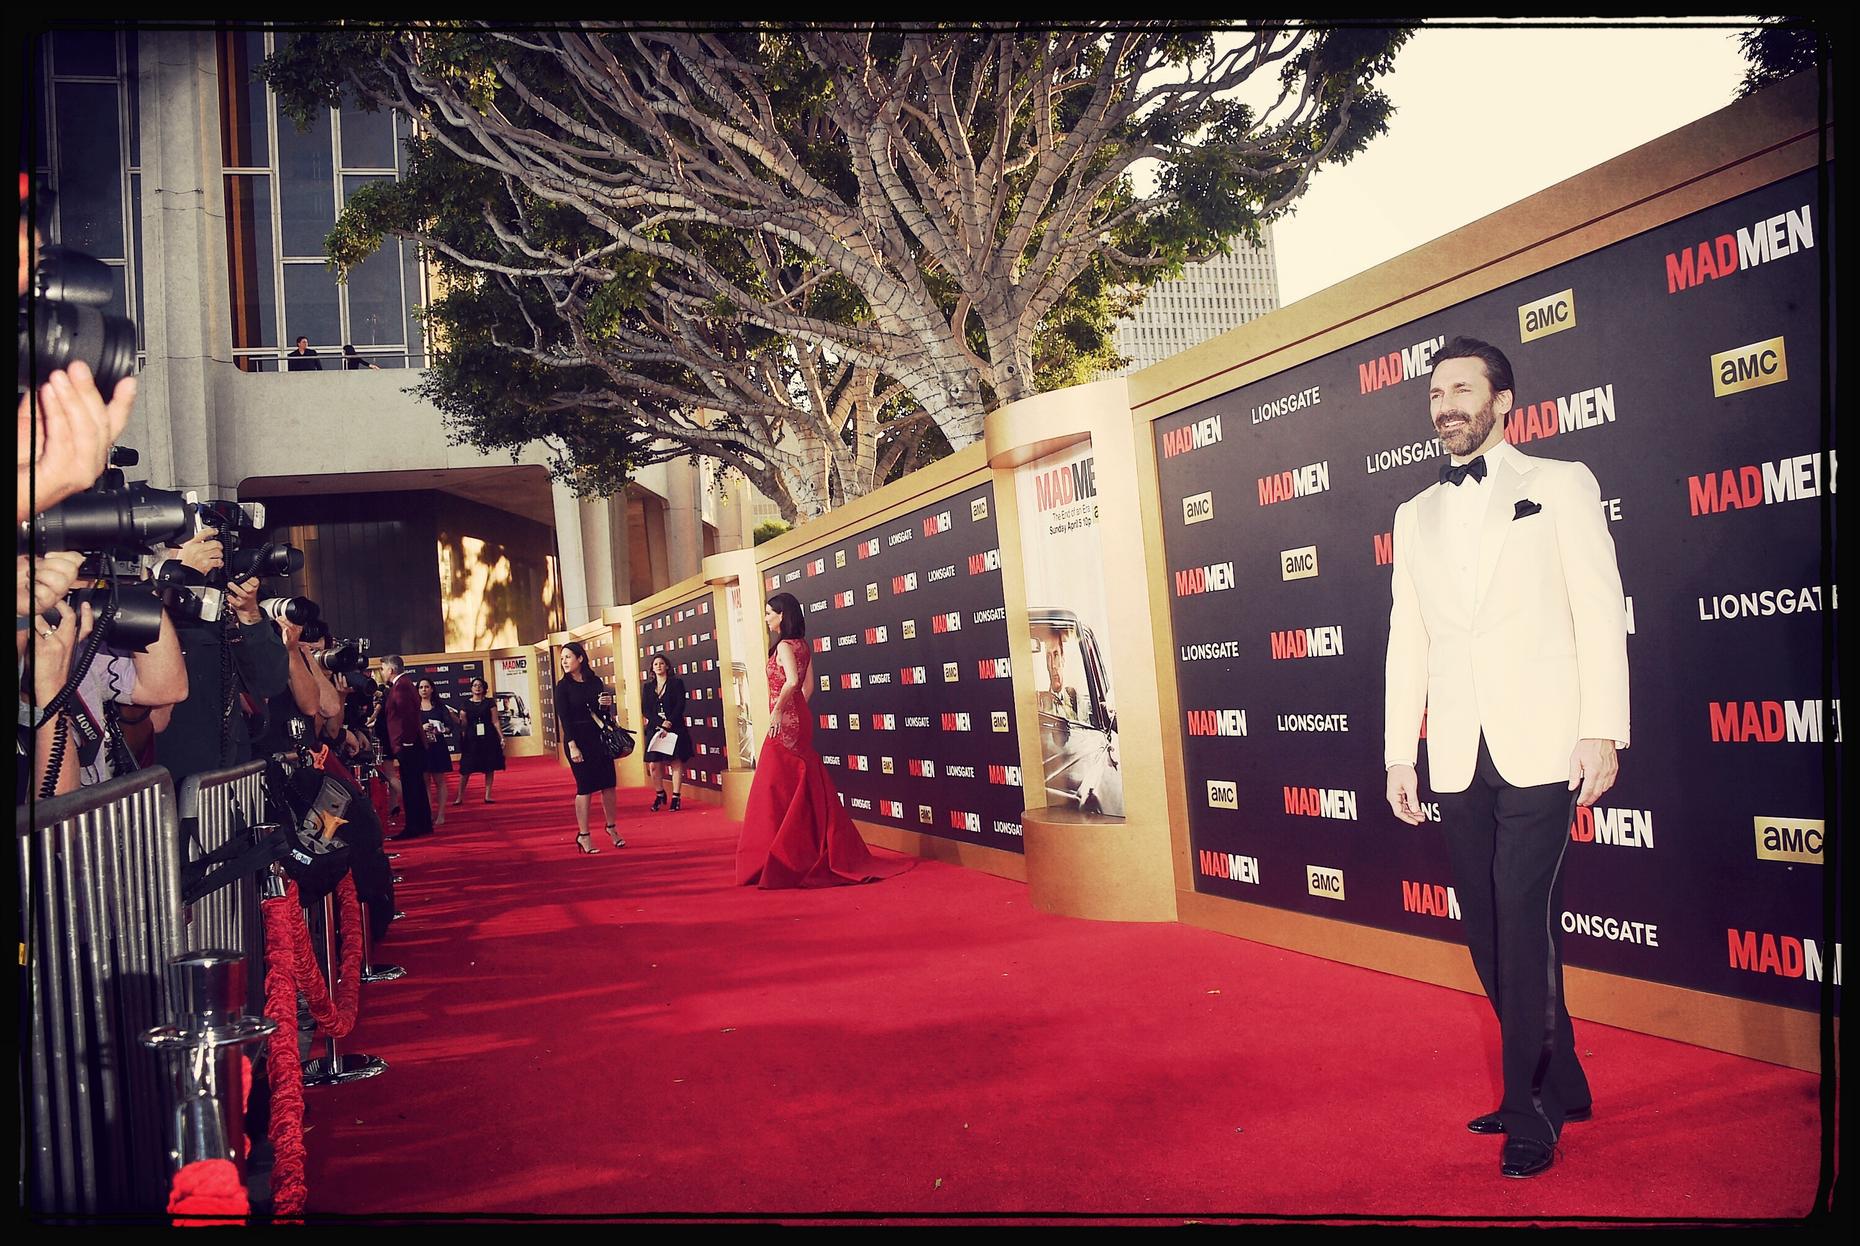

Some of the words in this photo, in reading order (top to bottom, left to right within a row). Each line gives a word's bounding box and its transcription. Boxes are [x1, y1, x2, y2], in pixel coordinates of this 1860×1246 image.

[1666, 205, 1814, 294] MADMEN
[1251, 385, 1321, 425] LIONSGATE
[1163, 415, 1223, 458] MADMEN
[1366, 437, 1448, 474] LIONSGAT
[1036, 457, 1097, 512] MADME
[1258, 461, 1330, 506] MADMEN
[1175, 561, 1235, 597] MADMEN
[1181, 640, 1239, 662] LIONSGATE
[1271, 625, 1343, 660] MADMEN
[1188, 709, 1247, 737] MADMEN
[1277, 714, 1349, 732] LIONSGATE
[1284, 786, 1358, 821] MADMEN
[994, 820, 1023, 837] LIONSGAT
[1570, 806, 1654, 849] DMEN
[1199, 849, 1260, 885] MADMEN
[1402, 880, 1461, 920] MADM
[1561, 911, 1659, 947] ONSGATE
[1727, 928, 1842, 986] MADM
